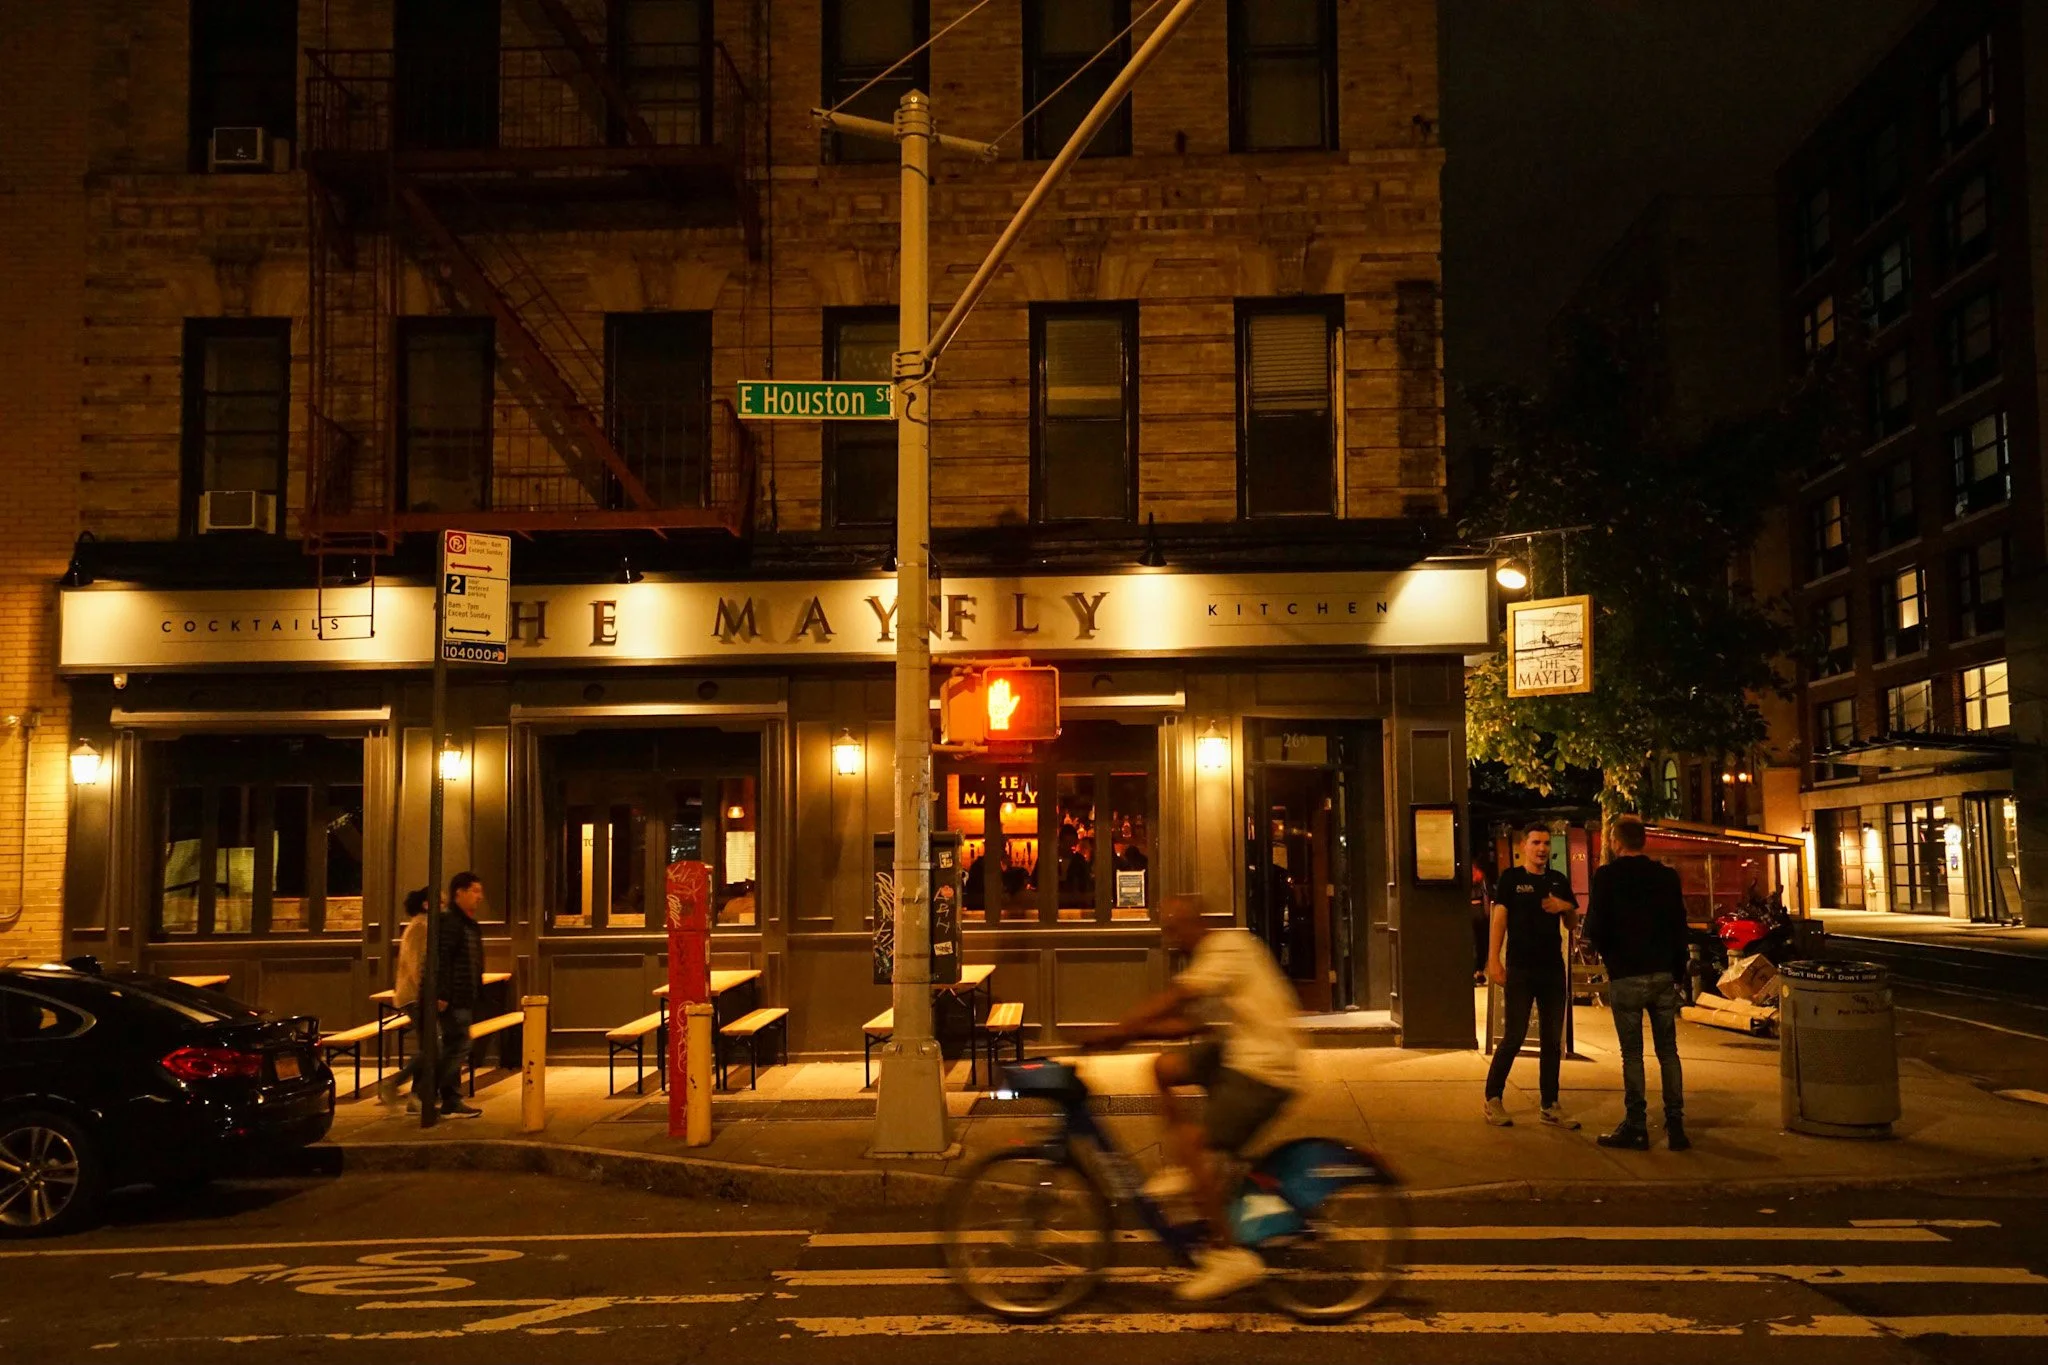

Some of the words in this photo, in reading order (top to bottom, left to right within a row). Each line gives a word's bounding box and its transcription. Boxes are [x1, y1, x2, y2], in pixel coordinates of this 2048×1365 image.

[741, 386, 752, 413] E
[763, 386, 865, 415] Houston
[876, 387, 891, 402] St
[487, 548, 504, 556] Sunday
[450, 575, 461, 593] 2
[448, 609, 468, 618] Except
[470, 610, 491, 620] Sunday
[1208, 602, 1387, 616] KITCHEN
[161, 618, 339, 633] COCKTAILS
[509, 600, 618, 646] HE
[711, 591, 1111, 640] MAYFLY
[1540, 659, 1560, 669] THE
[1518, 668, 1580, 687] MAYFLY
